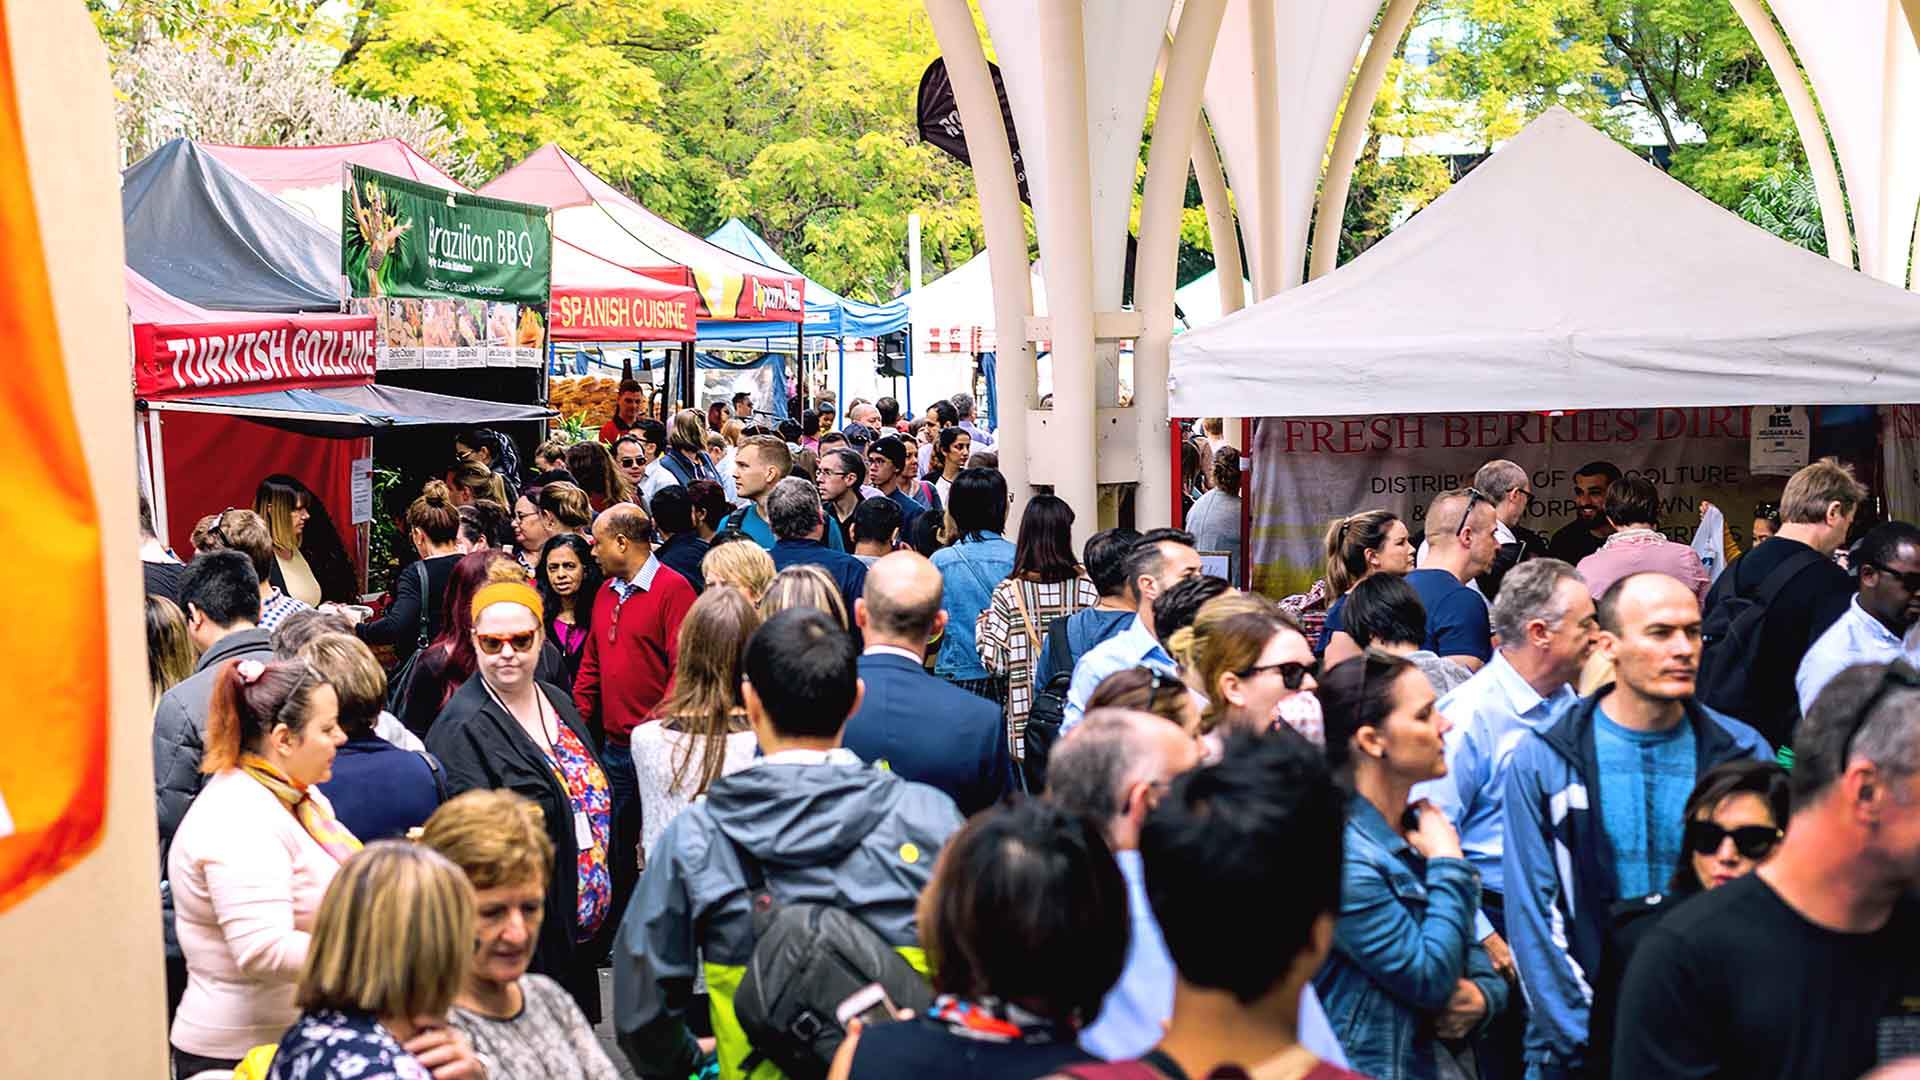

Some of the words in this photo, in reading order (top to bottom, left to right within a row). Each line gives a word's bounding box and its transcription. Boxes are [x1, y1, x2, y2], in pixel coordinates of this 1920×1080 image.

[428, 215, 493, 263] Brazilian
[497, 229, 533, 269] BBQ
[560, 295, 631, 328] SPANISH
[632, 298, 688, 330] CUISINE
[166, 329, 292, 388] TURKISH
[291, 328, 375, 377] GOZLEME
[1282, 415, 1429, 453] FRESH
[1440, 410, 1640, 448] BERRIES
[1371, 474, 1463, 494] DISTRIB
[1532, 470, 1566, 489] OF
[1412, 504, 1425, 521] &
